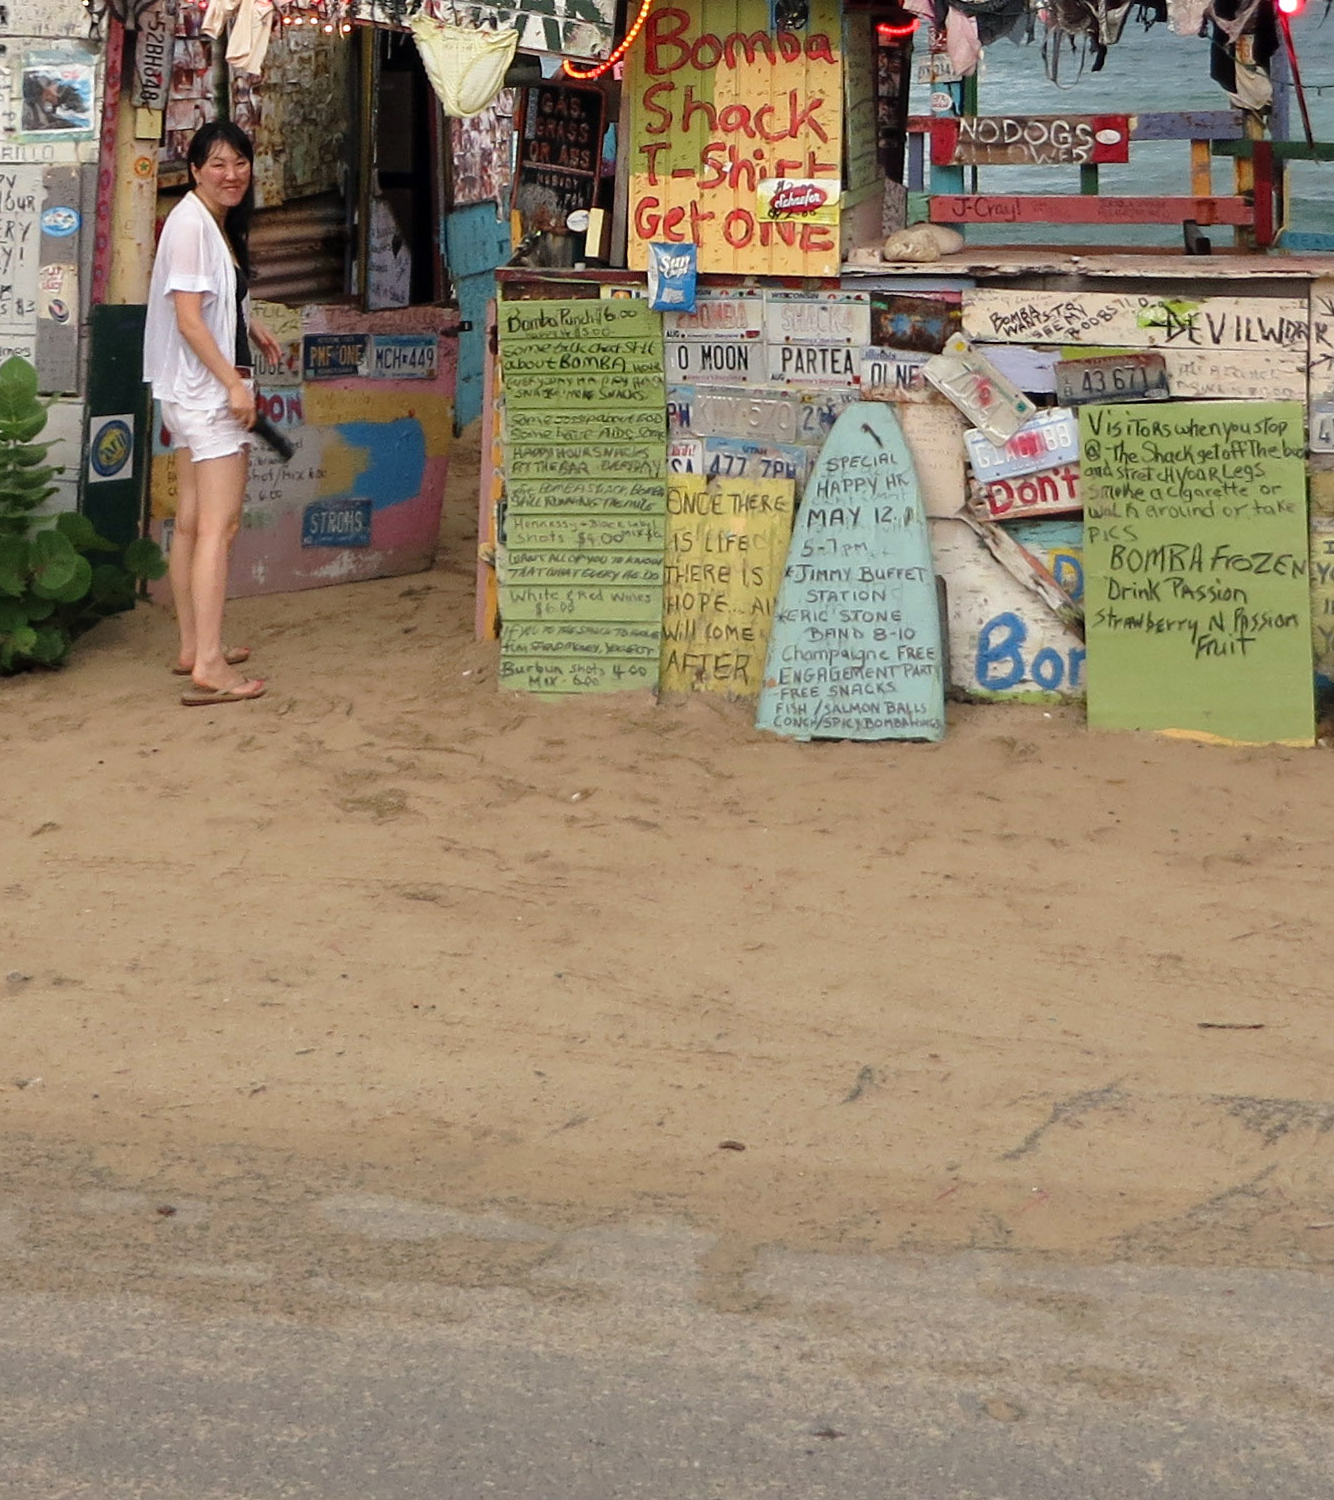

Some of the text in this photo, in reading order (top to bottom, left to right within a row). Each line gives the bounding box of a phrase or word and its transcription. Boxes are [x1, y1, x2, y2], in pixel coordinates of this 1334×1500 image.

[643, 7, 839, 76] Bomba
[641, 82, 829, 144] Shack
[774, 188, 822, 209] Schaefer
[634, 195, 715, 248] Get
[659, 254, 691, 273] Sun
[701, 345, 749, 371] MOON
[781, 347, 854, 374] PARTEA
[825, 452, 898, 472] SPECIAL
[1141, 440, 1195, 465] Shack
[710, 454, 747, 477] 477
[816, 476, 878, 499] HAPPY
[985, 467, 1080, 514] Don't
[667, 485, 723, 516] ONCE
[727, 492, 789, 515] THERE
[806, 505, 861, 529] MAY
[1109, 541, 1203, 573] BOMBA
[664, 563, 731, 586] THERE
[857, 565, 928, 583] BUFFET
[806, 589, 887, 604] STATION
[839, 609, 903, 623] STONE
[804, 626, 916, 643] BAND 8-10
[897, 644, 937, 661] FREE
[667, 649, 750, 685] AFTER
[779, 664, 899, 685] ENGAGEMENT
[826, 681, 897, 698] SNACKS
[775, 700, 928, 715] FISH BALLS
